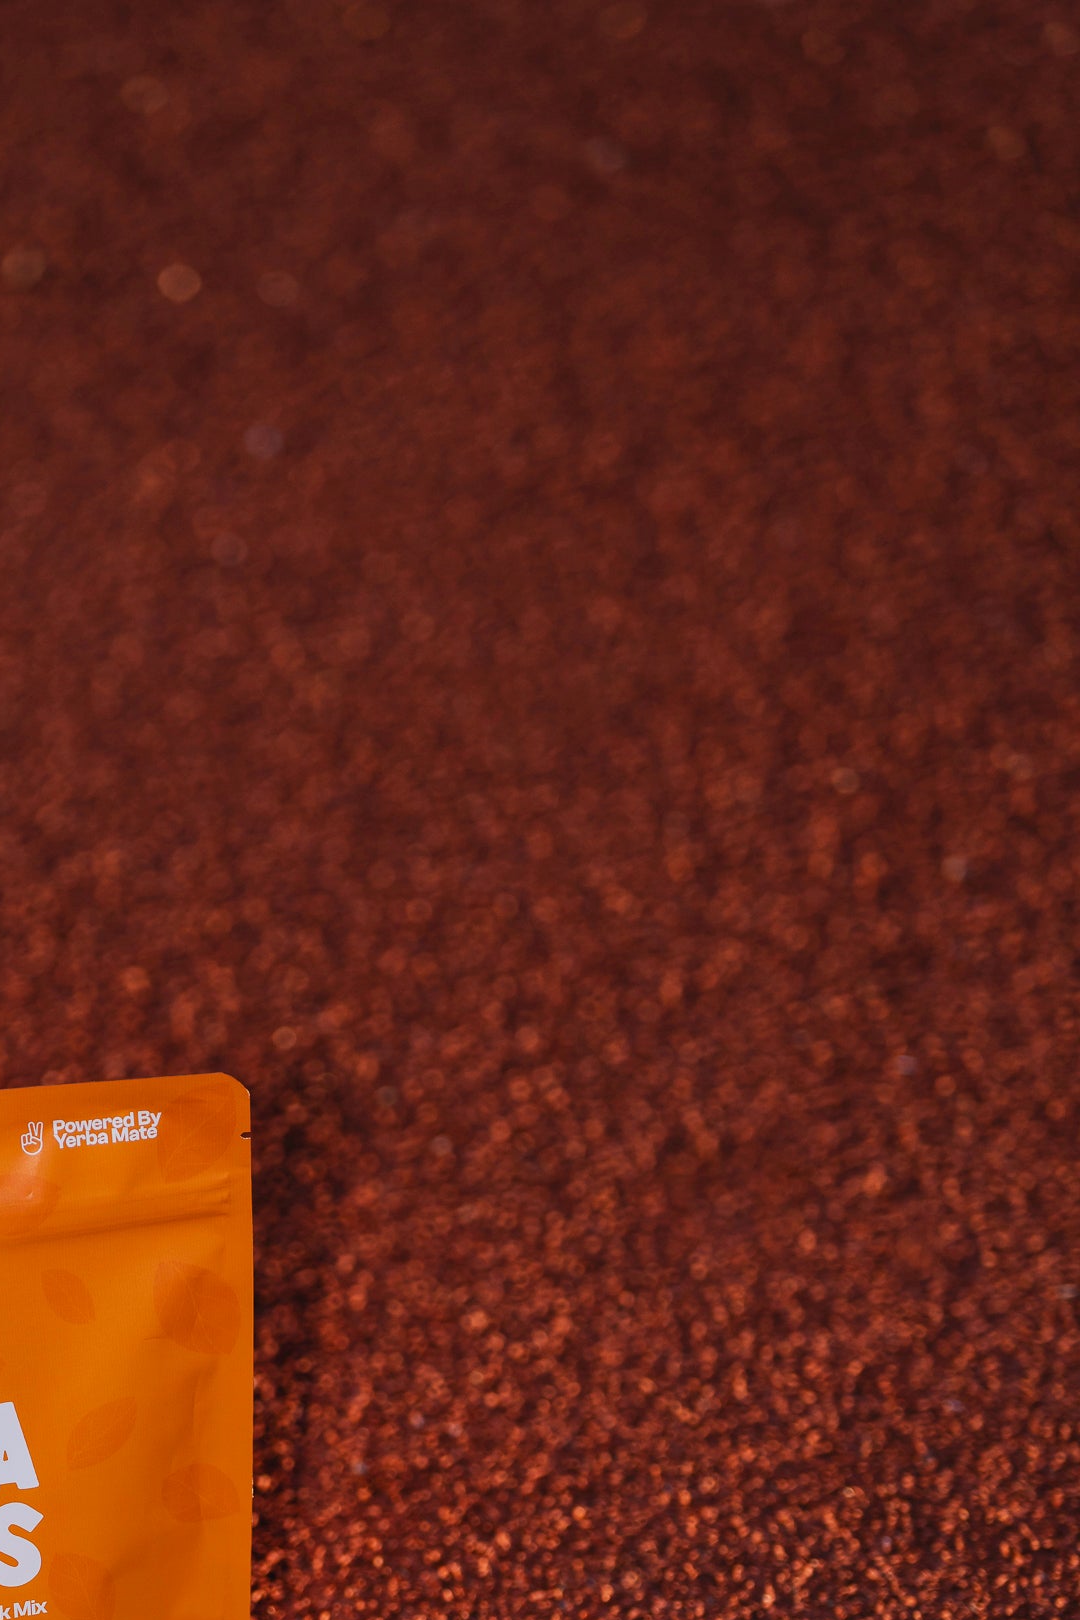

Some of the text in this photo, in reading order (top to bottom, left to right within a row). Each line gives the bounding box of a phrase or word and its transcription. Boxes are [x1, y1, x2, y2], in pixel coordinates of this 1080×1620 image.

[52, 1110, 162, 1136] Powered By
[53, 1126, 158, 1149] Yerba Mate
[13, 1600, 48, 1619] Mix
